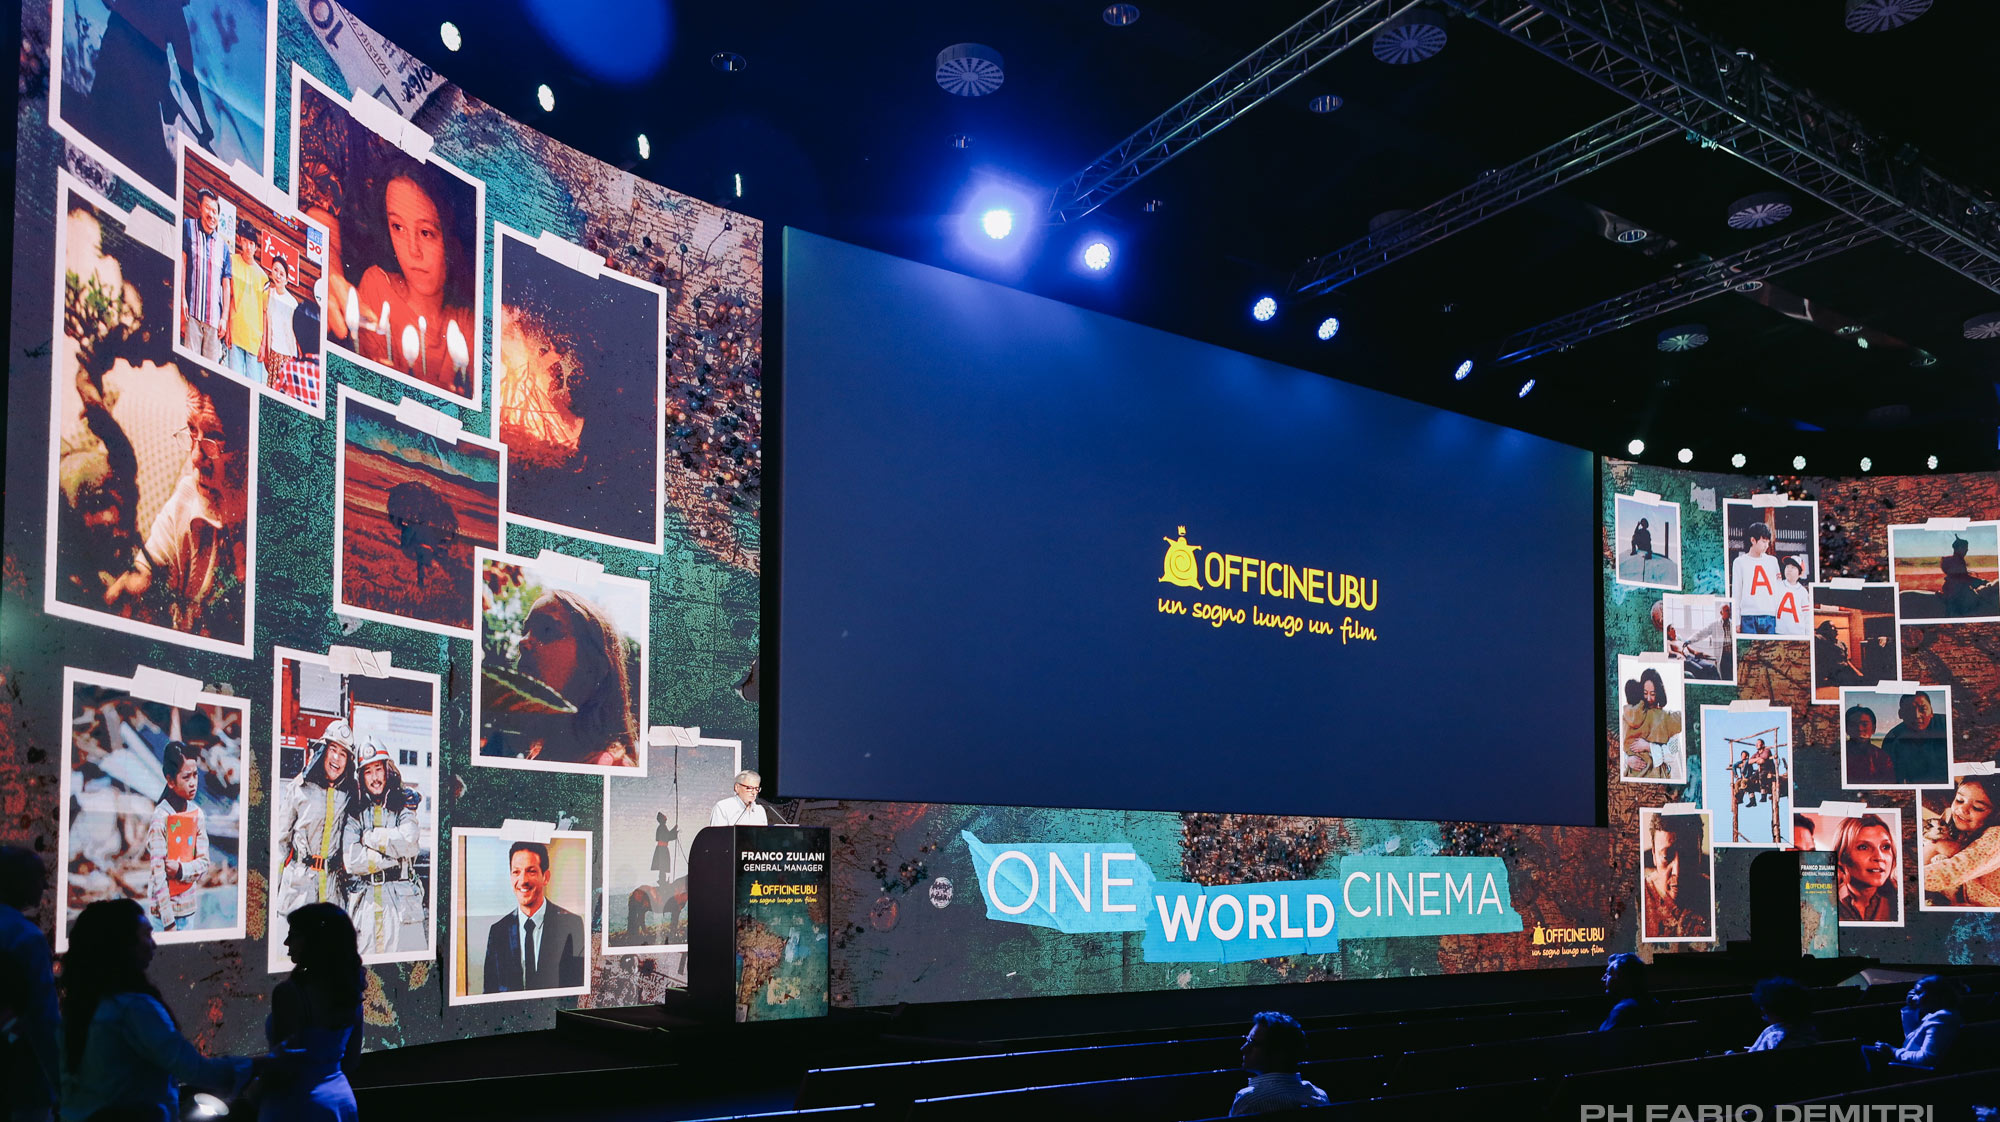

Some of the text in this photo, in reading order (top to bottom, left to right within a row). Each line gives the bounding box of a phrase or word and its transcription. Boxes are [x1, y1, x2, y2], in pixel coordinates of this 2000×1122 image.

[1750, 565, 1773, 596] A
[1158, 598, 1378, 645] un sogno lungo un film
[1776, 592, 1800, 623] A
[741, 851, 825, 862] FRANCO ZULIANI
[743, 864, 823, 872] GENERAL MANAGER
[986, 850, 1138, 916] ONE
[1155, 894, 1336, 943] WORLD
[1343, 870, 1505, 919] CINEMA
[1542, 948, 1560, 959] sogno
[1561, 946, 1580, 958] lungo
[1590, 944, 1605, 957] film
